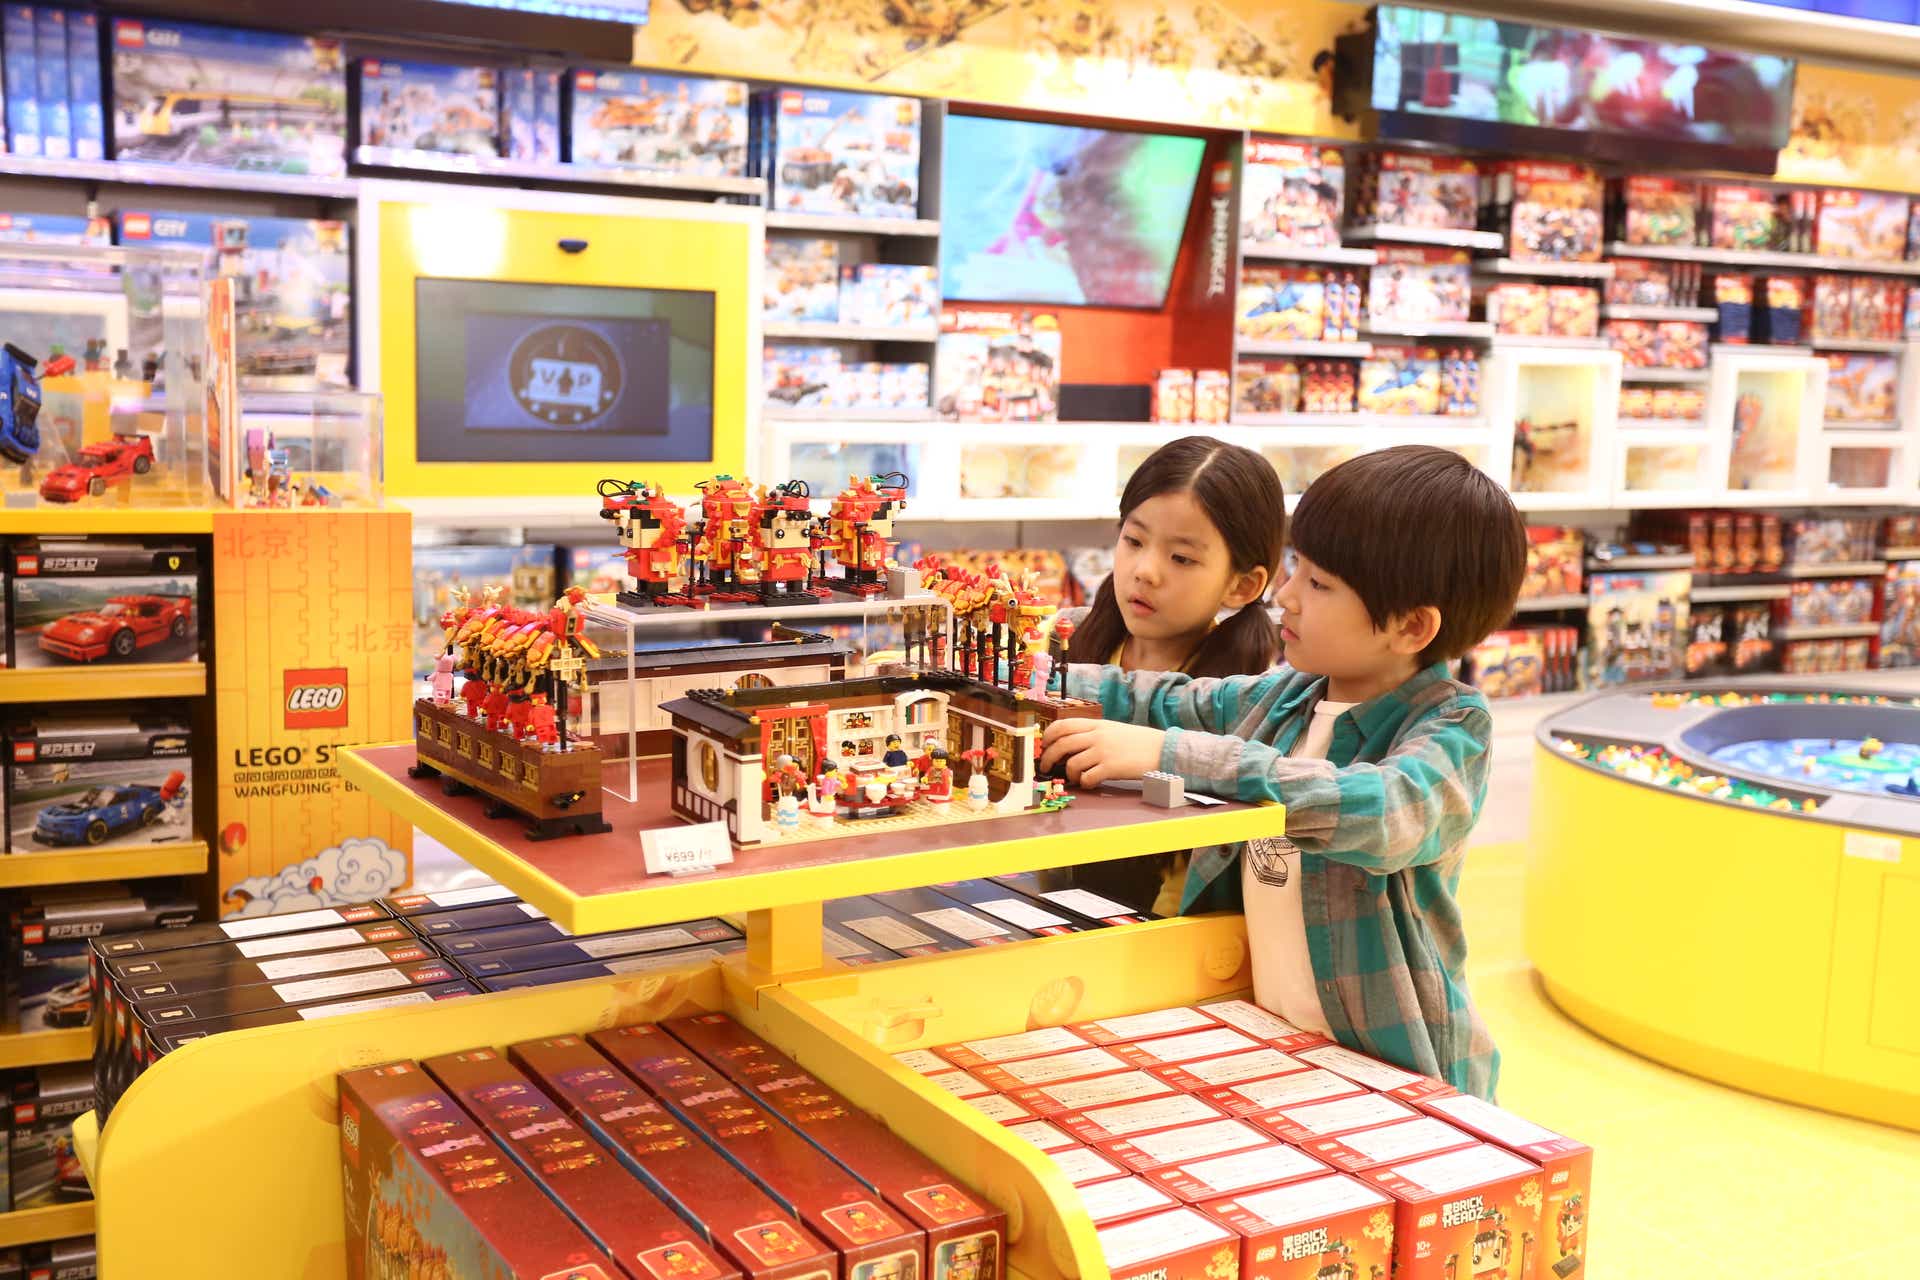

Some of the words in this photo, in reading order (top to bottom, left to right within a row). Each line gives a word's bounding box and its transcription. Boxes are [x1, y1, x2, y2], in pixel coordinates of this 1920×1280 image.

[223, 528, 292, 559] 北京
[42, 558, 98, 572] SPEED
[347, 624, 412, 652] 北京
[288, 686, 344, 711] LEGO
[40, 742, 95, 757] SPEED
[235, 783, 331, 798] WANGFUJING
[48, 922, 104, 937] SPEED
[1453, 1196, 1484, 1212] BRICK
[1442, 1207, 1485, 1228] HEADZ
[1294, 1227, 1328, 1246] BRICK
[1282, 1239, 1329, 1262] HEADZ
[1416, 1240, 1431, 1252] 10+
